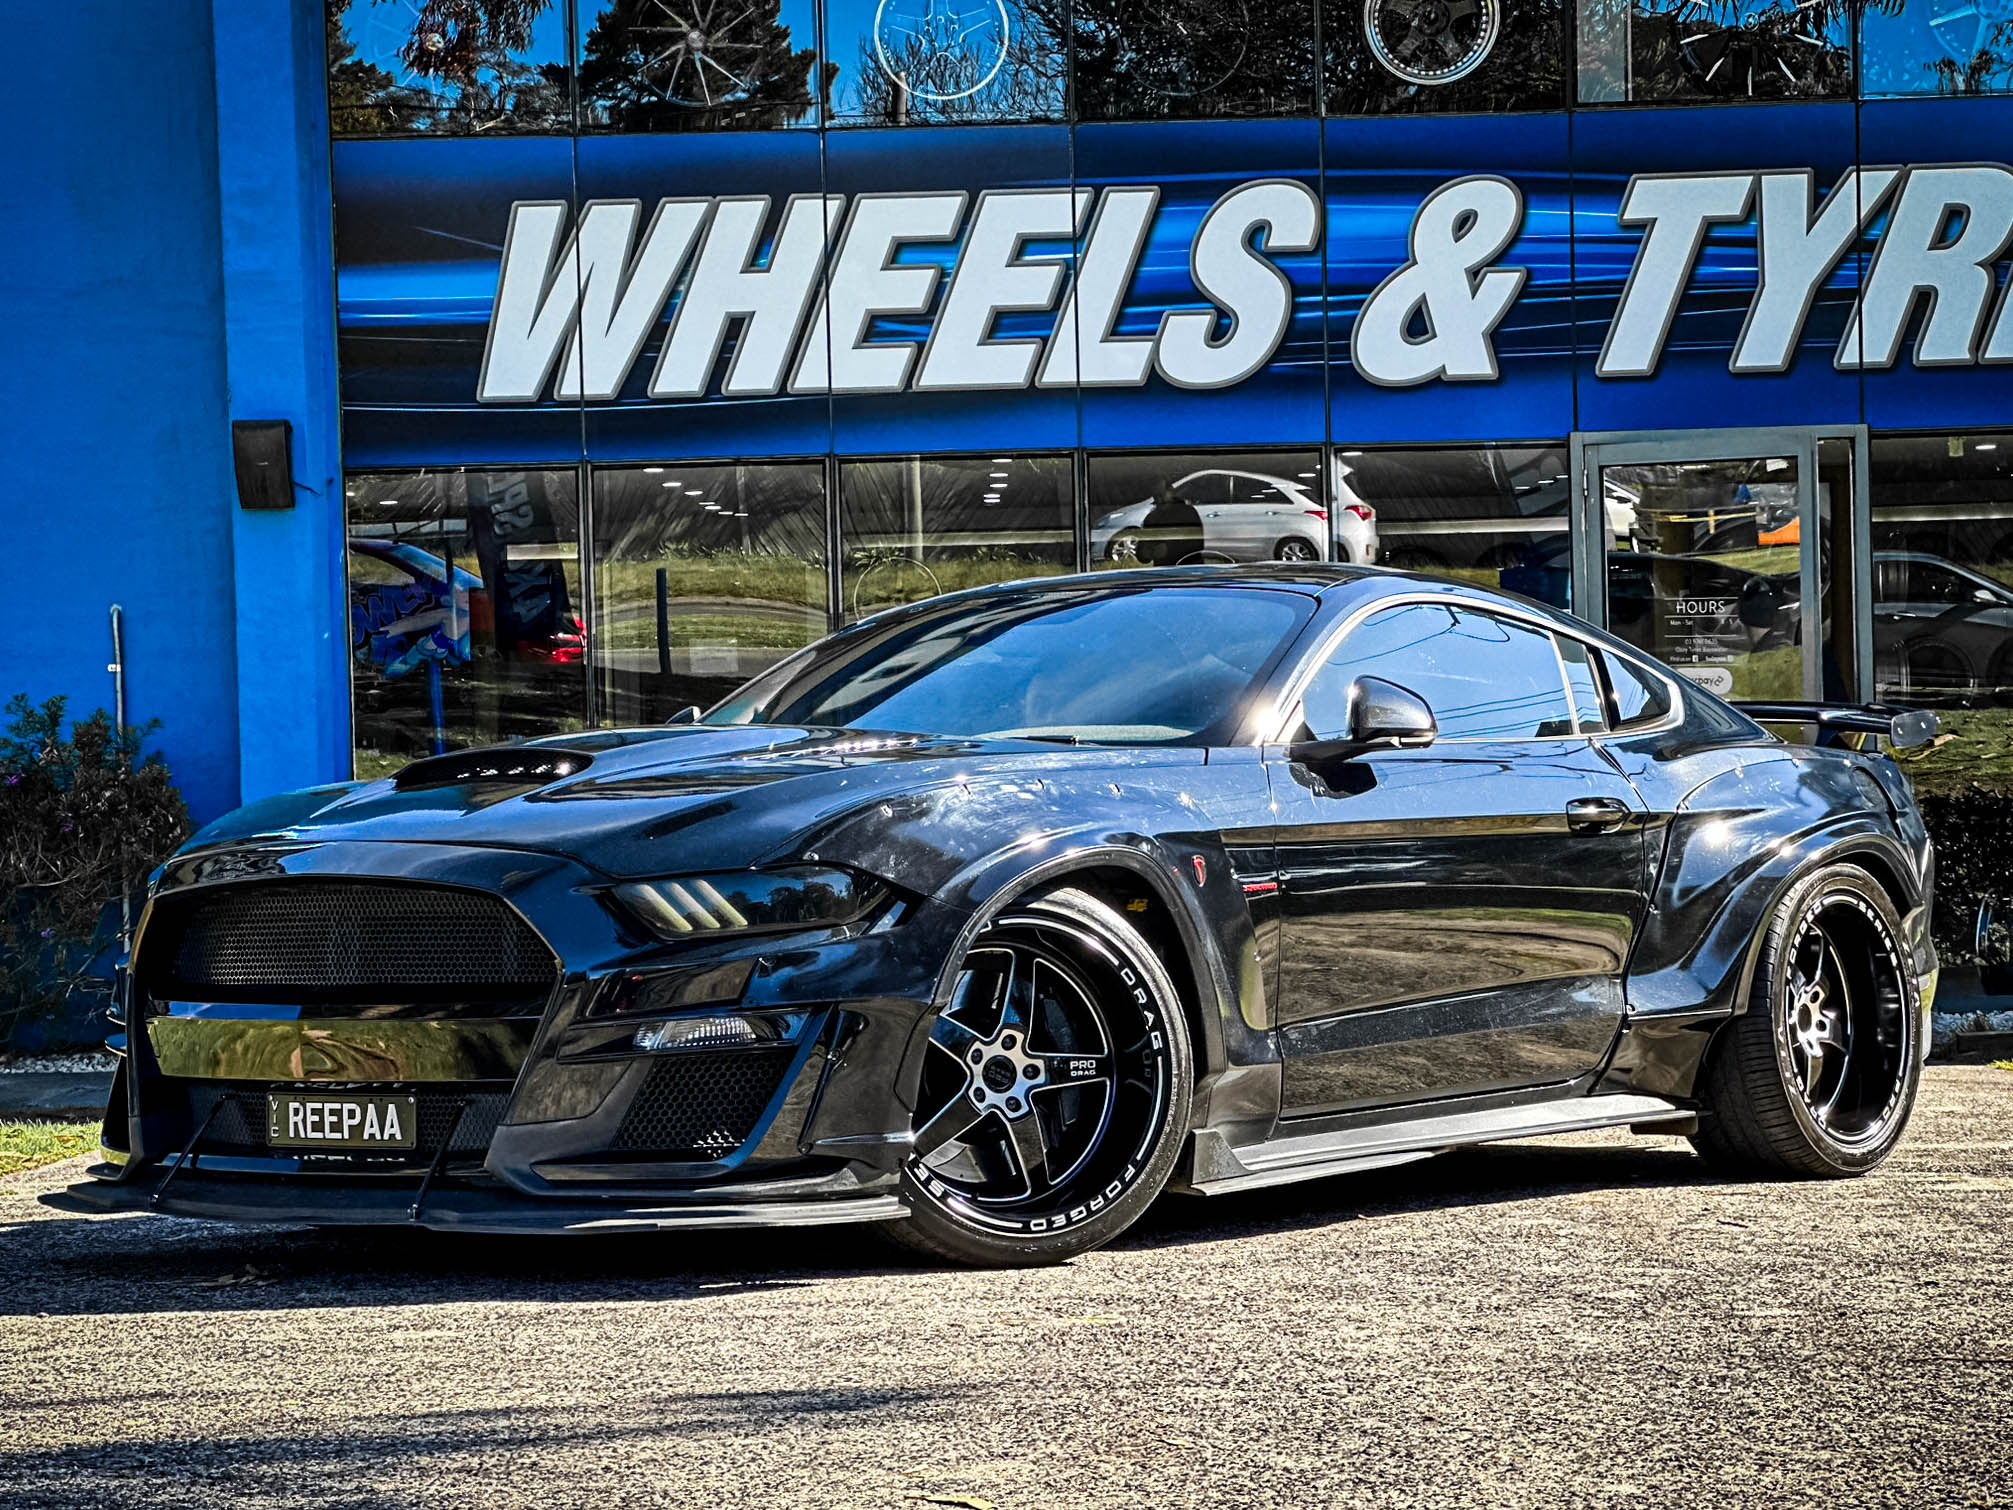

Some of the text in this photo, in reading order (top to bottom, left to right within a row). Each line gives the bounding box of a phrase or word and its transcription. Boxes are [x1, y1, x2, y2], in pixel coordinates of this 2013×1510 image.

[476, 162, 2013, 402] WHEELS & TYR
[1676, 600, 1725, 614] HOURS
[1120, 967, 1163, 1050] DRAG
[1070, 1060, 1096, 1070] PRO
[271, 1100, 279, 1138] VIC
[288, 1101, 402, 1141] REEPAA
[1030, 1164, 1136, 1232] FORGED
